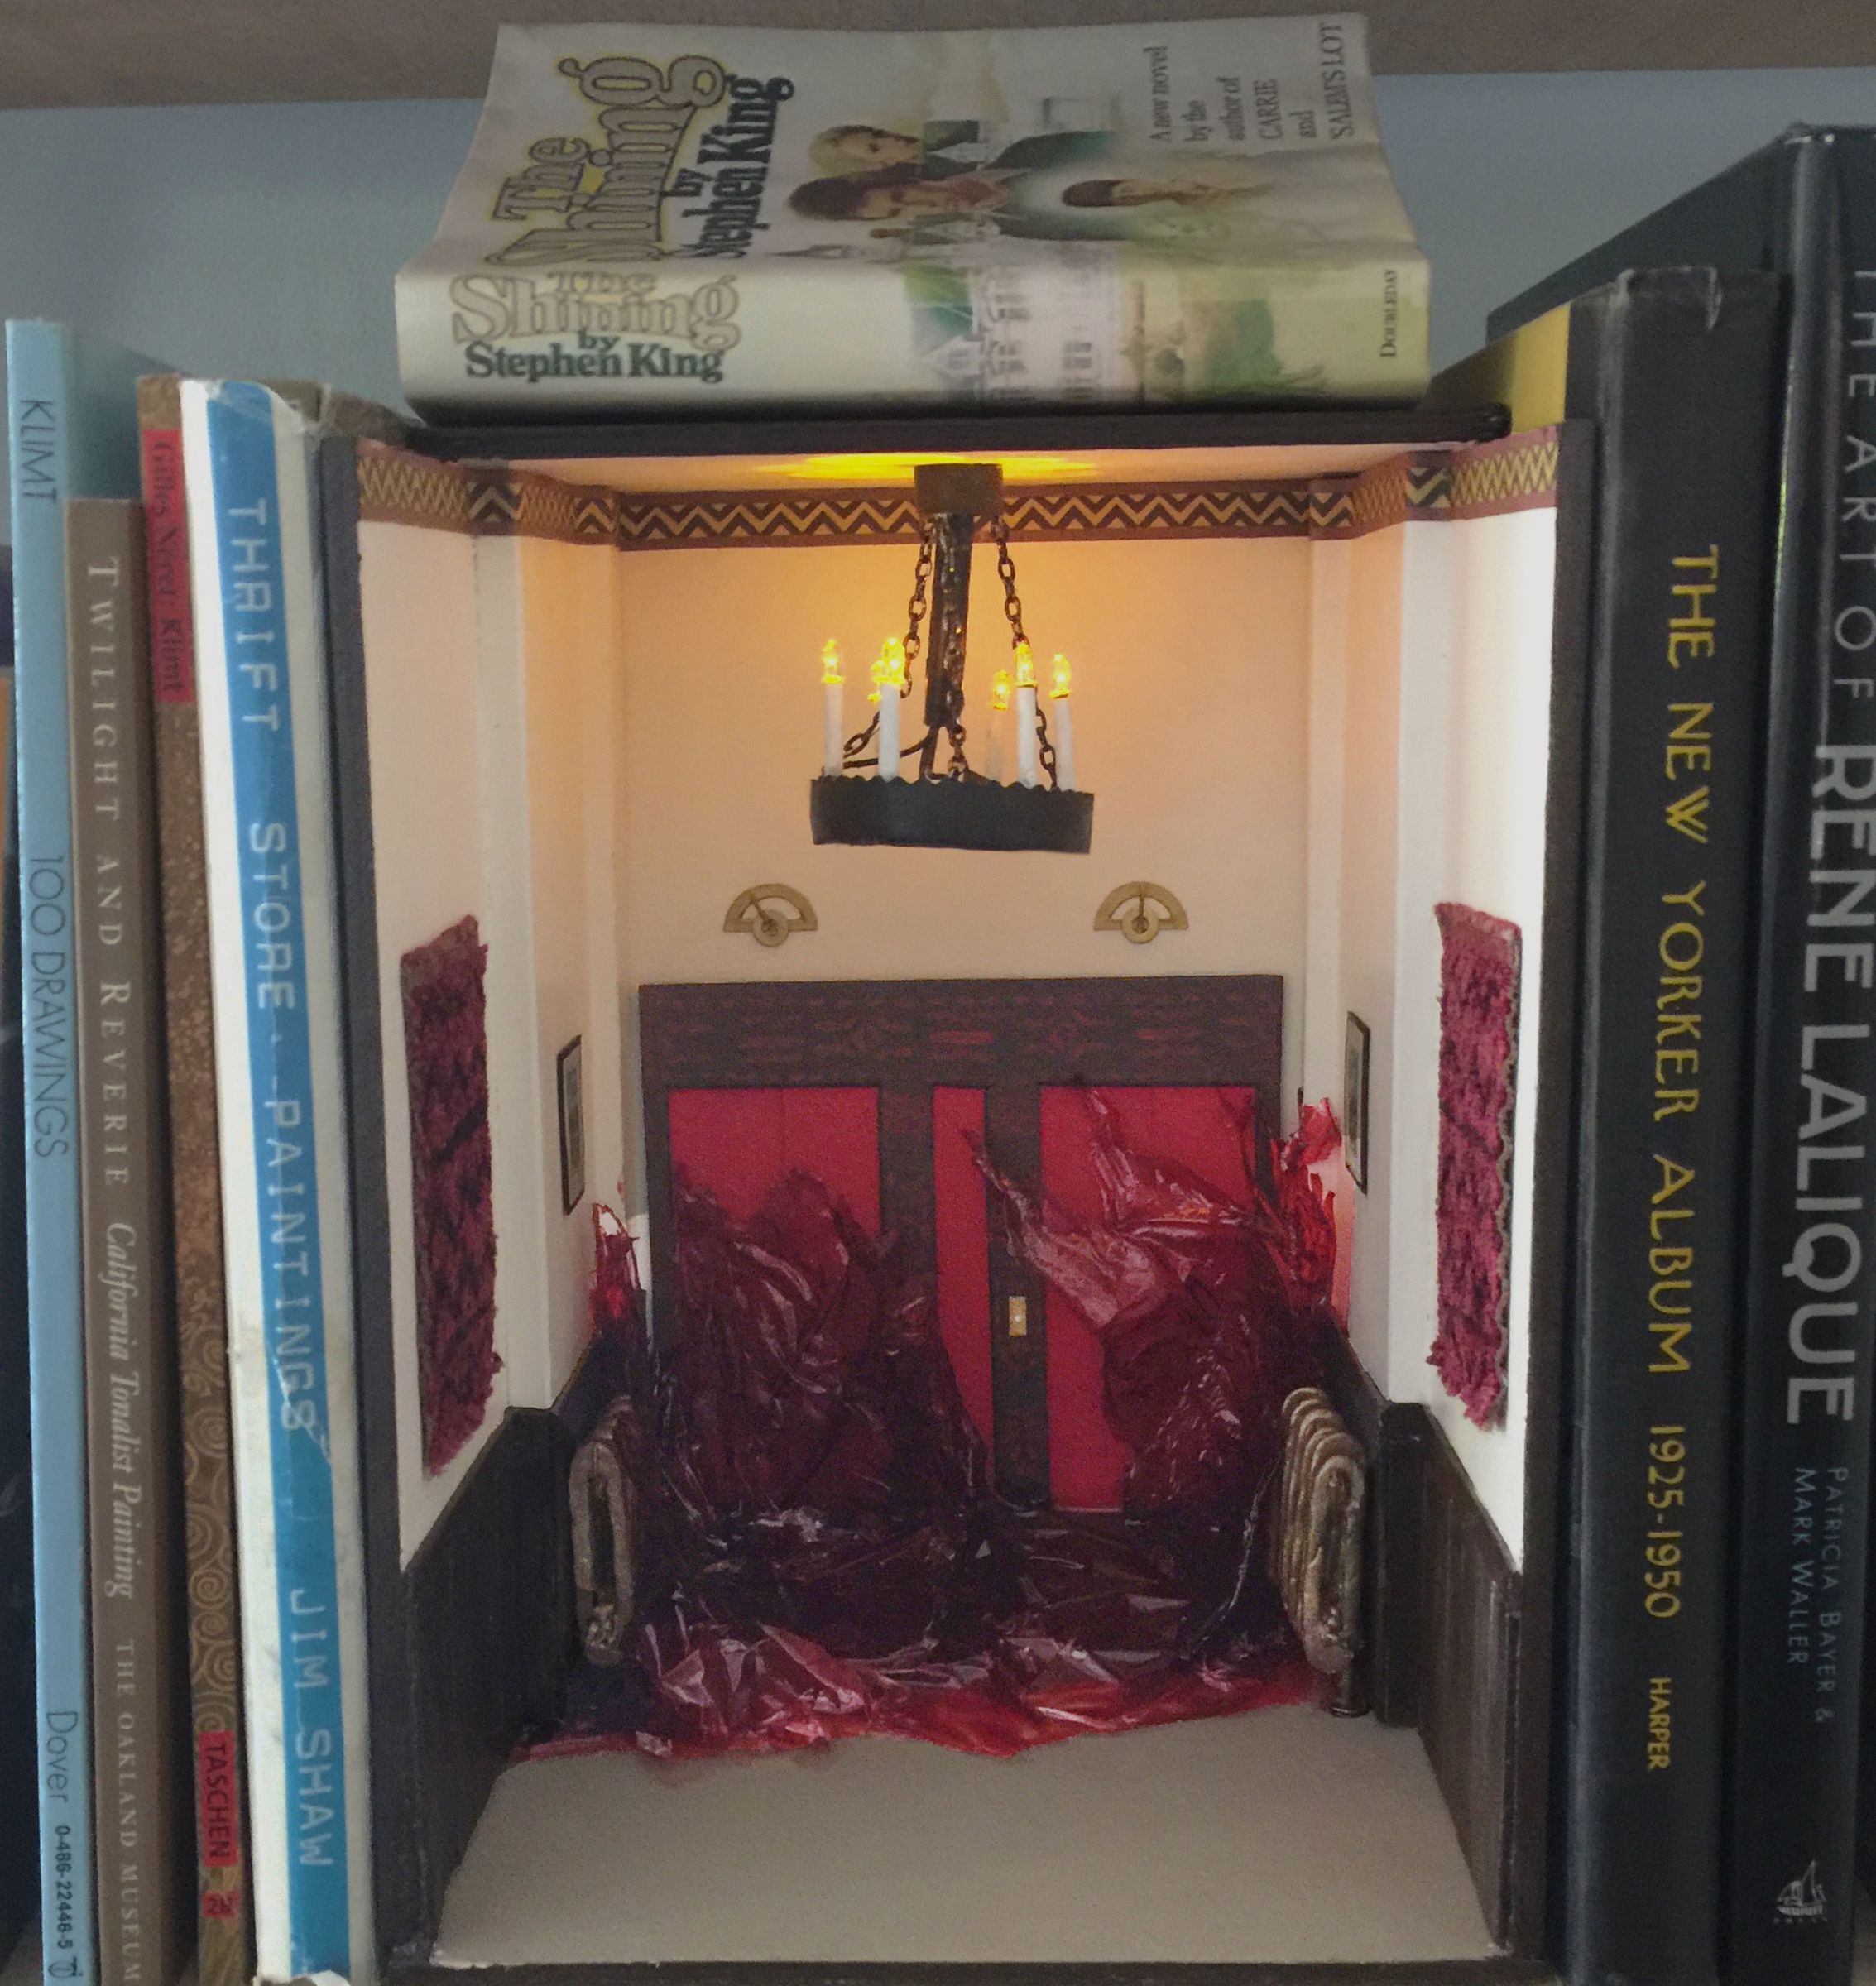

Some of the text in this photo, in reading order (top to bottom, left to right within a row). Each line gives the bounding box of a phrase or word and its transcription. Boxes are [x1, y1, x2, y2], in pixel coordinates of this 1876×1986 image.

[1319, 22, 1345, 66] LOT
[697, 73, 795, 164] King
[1143, 46, 1172, 142] A new novel
[1180, 100, 1213, 142] by the
[1215, 77, 1245, 140] author of
[1253, 79, 1283, 140] CARRIE
[1288, 110, 1317, 138] and
[492, 137, 591, 220] The
[661, 167, 717, 198] by
[449, 272, 741, 352] Shining
[546, 271, 658, 294] The
[464, 340, 725, 384] Stephen King
[578, 329, 622, 353] by
[1840, 435, 1876, 568] ART
[1834, 605, 1876, 699] OF
[20, 399, 70, 1158] KLIMT 100 DRAWINGS
[1802, 745, 1876, 993] RENE
[228, 498, 317, 1431] THRIFT STORE PAINTINGS
[87, 555, 142, 1599] TWILIGHT AND REVERIE California Tonalist Painting
[1644, 544, 1719, 1619] THE NEW YORKER ALBUM 1925-1950
[1782, 1024, 1870, 1425] LALIQUE
[1788, 1467, 1818, 1664] MARK WALLER
[1822, 1467, 1849, 1590] PATRICIA
[1817, 1613, 1842, 1692] BAYER
[46, 1710, 79, 1803] Dover
[290, 1587, 333, 1866] JIM SHAW
[1647, 1677, 1672, 1772] HARPER
[116, 1639, 141, 1981] THE OAKLAND MUSEUM
[205, 1741, 231, 1858] TASCHEN
